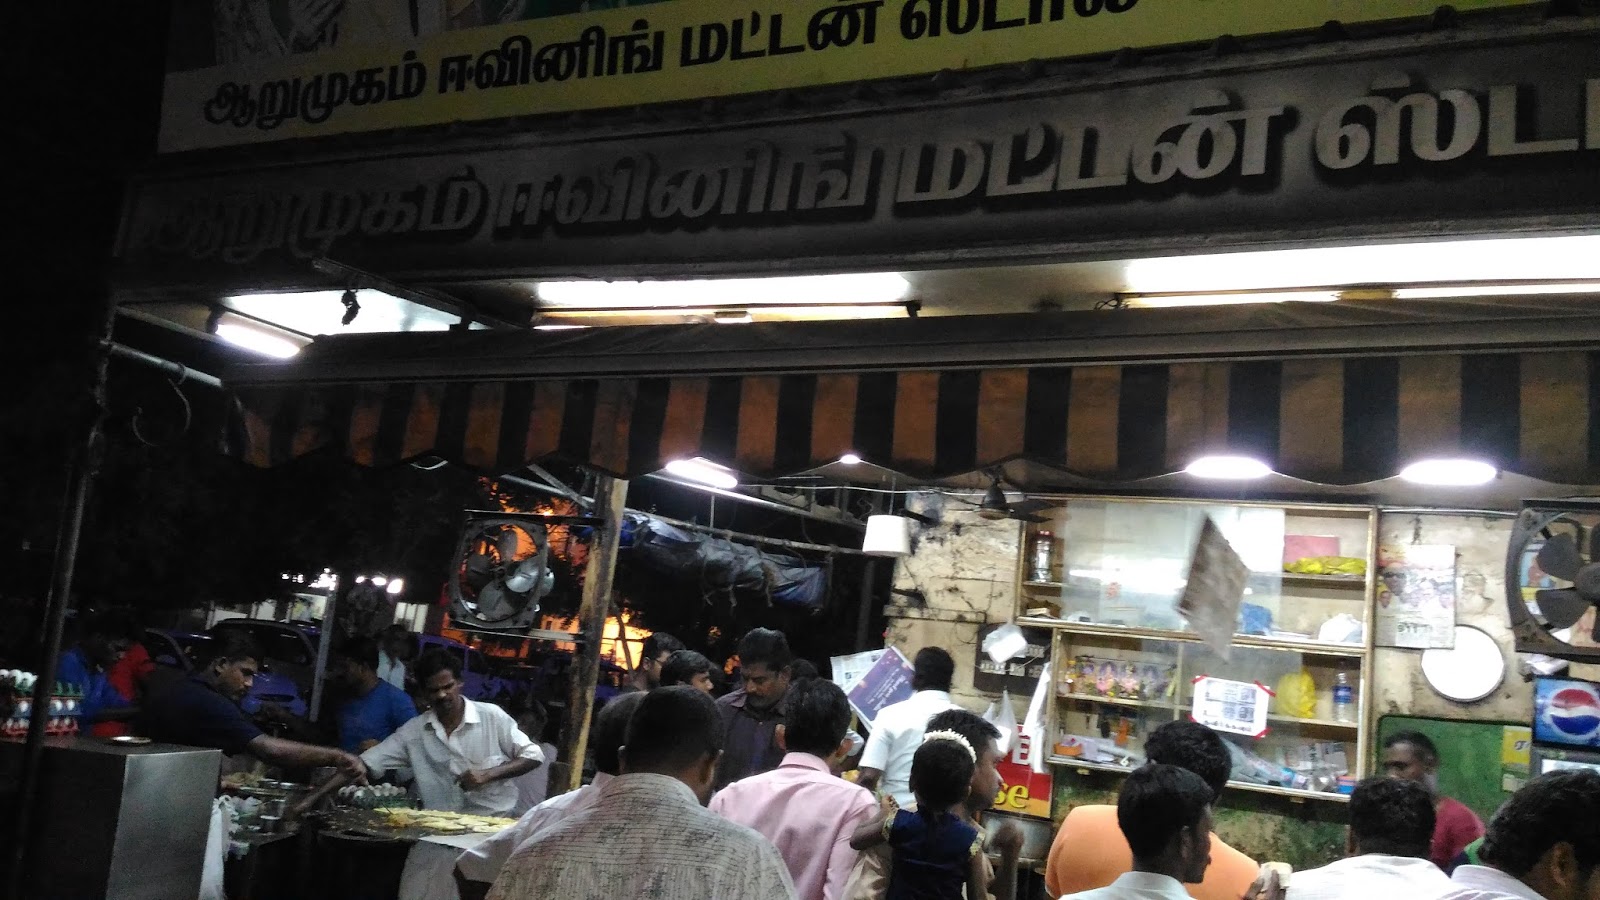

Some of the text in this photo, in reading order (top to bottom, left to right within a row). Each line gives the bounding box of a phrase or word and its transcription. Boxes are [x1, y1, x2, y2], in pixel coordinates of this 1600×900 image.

[204, 50, 426, 129] ஆறுமுகம்
[438, 19, 664, 94] ஈவினிங்
[680, 0, 884, 67] மட்டன்
[502, 131, 880, 227] ஈவினிங்
[894, 89, 1285, 203] மட்டன்
[1315, 74, 1600, 170] ஸ்ட
